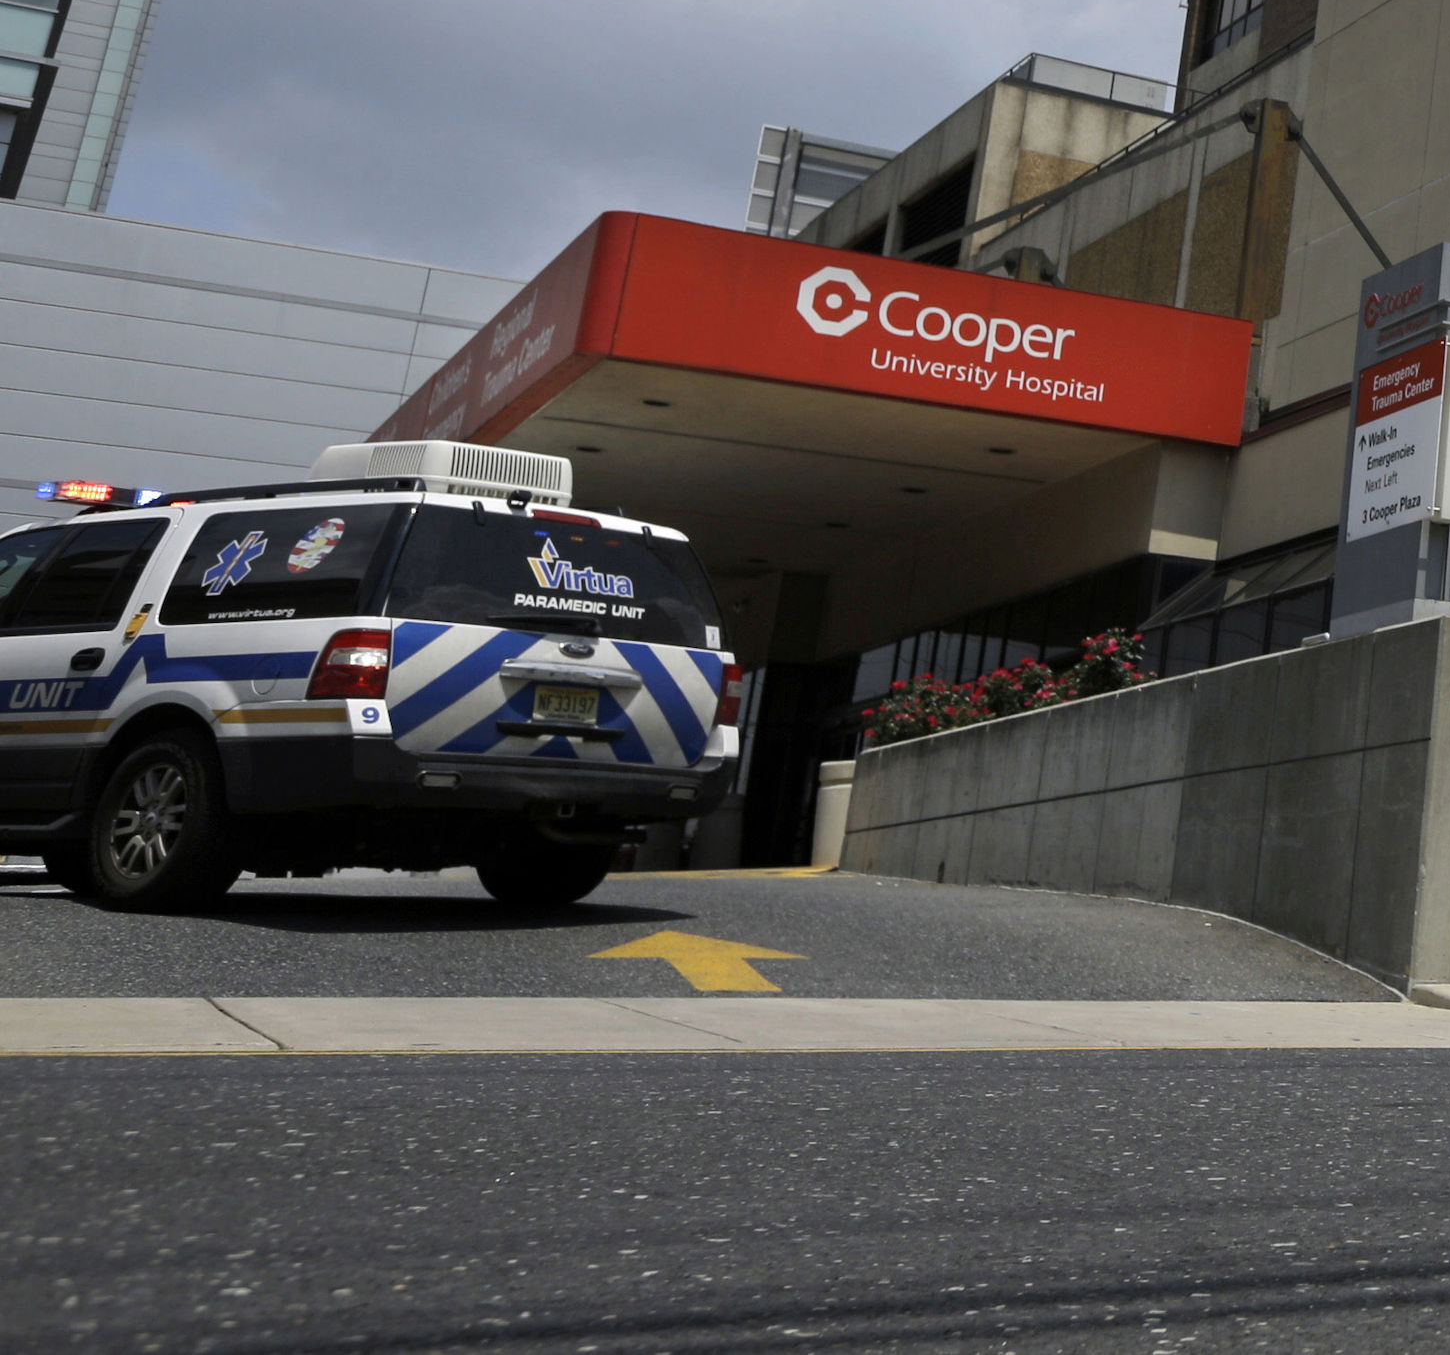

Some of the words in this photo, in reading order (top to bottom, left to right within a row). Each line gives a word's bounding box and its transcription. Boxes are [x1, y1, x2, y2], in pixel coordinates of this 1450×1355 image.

[879, 290, 1076, 363] Cooper
[870, 347, 998, 391] University
[1006, 369, 1105, 402] Hospital
[1373, 362, 1421, 392] Emergency
[1372, 390, 1403, 412] Trauma
[1405, 378, 1435, 399] Center
[1368, 426, 1398, 448] Walk-In
[1367, 444, 1416, 472] Emergencies
[1364, 478, 1382, 494] Next
[1384, 471, 1398, 488] Left
[1362, 510, 1368, 524] 3
[1369, 502, 1398, 522] Cooper
[1400, 495, 1421, 512] Plaza
[527, 555, 634, 598] Virtua
[207, 608, 296, 620] www.virtua.org
[513, 593, 606, 616] PARAMEDIC
[611, 604, 646, 620] UNIT
[9, 681, 85, 709] UNIT
[361, 706, 380, 724] 9
